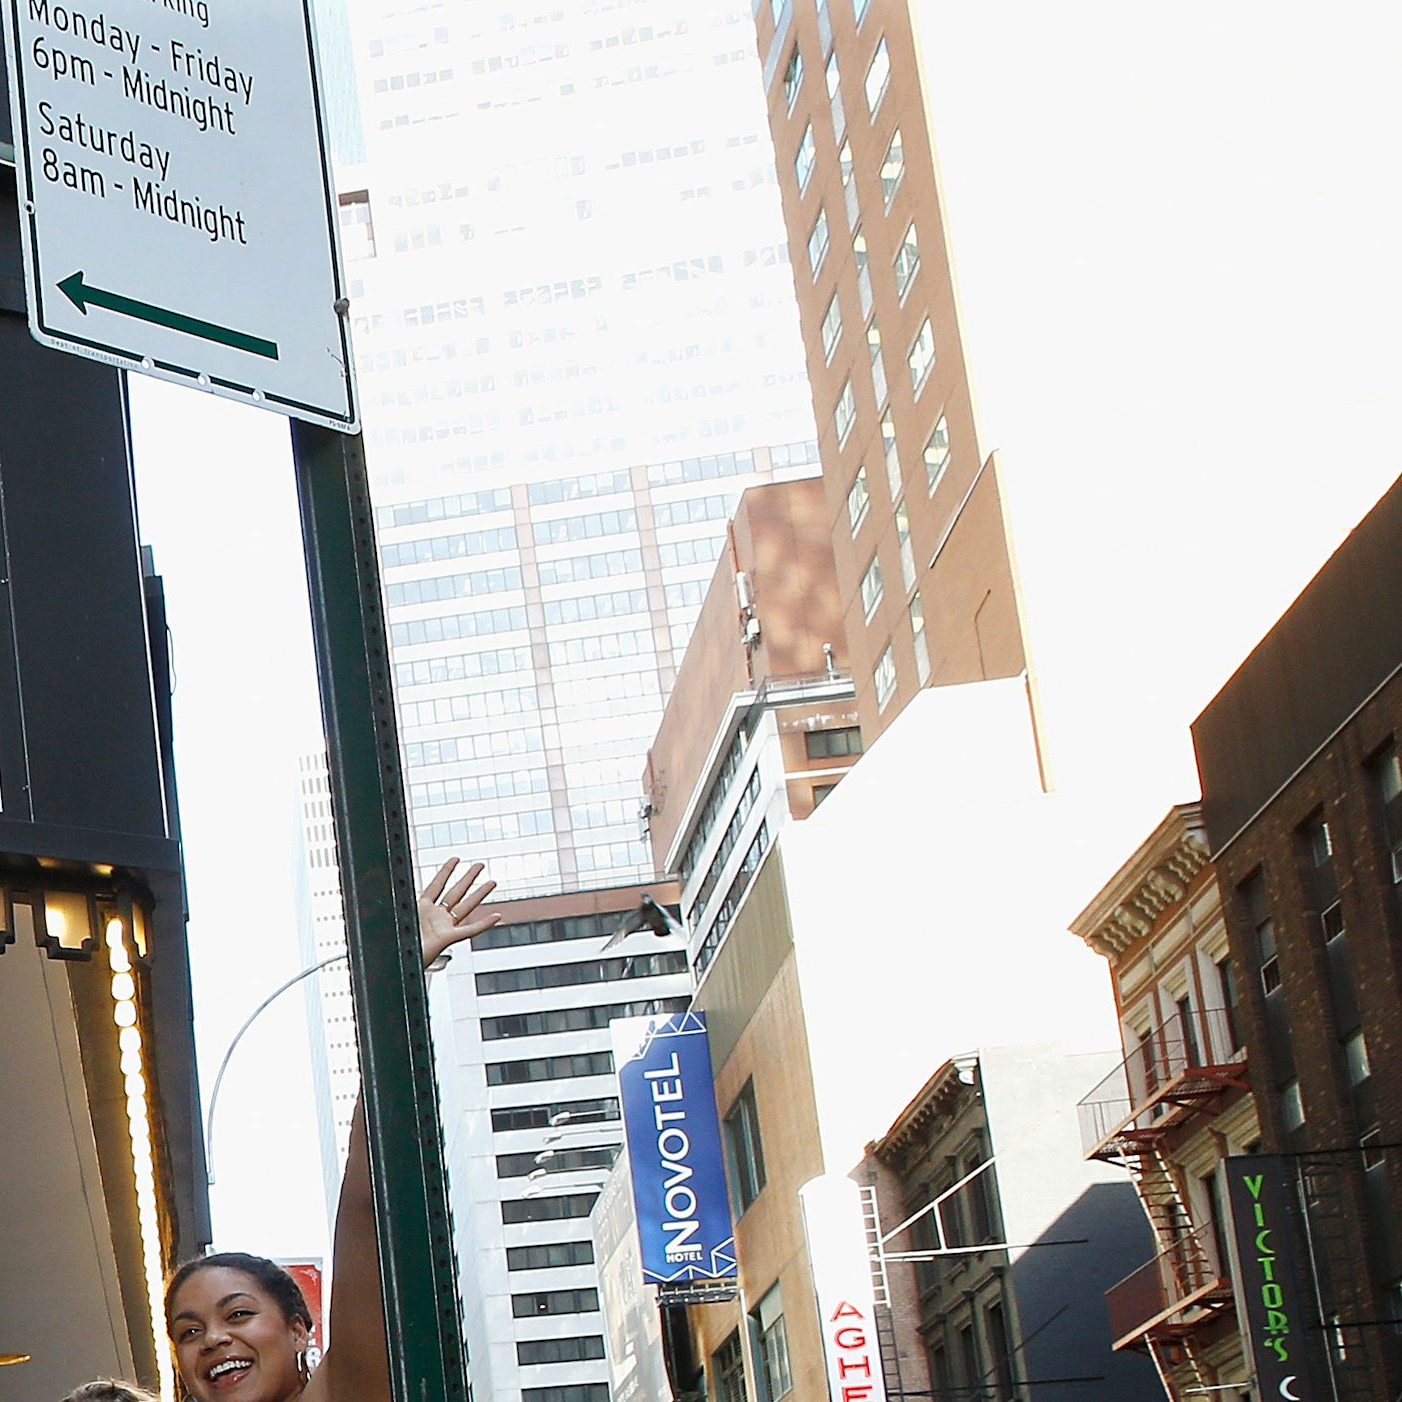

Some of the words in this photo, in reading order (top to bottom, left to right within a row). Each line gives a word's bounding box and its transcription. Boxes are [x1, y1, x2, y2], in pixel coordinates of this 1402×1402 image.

[28, 0, 140, 64] Monday
[171, 40, 253, 105] Friday
[145, 0, 210, 28] king
[33, 37, 95, 85] 6pm
[122, 65, 235, 137] Midnight
[38, 102, 170, 182] Saturday
[42, 149, 105, 198] 8am
[133, 176, 247, 246] Midnight
[644, 1052, 703, 1254] NOVOTEL
[666, 1251, 703, 1263] HOTEL
[1242, 1174, 1290, 1362] VICTOR'S
